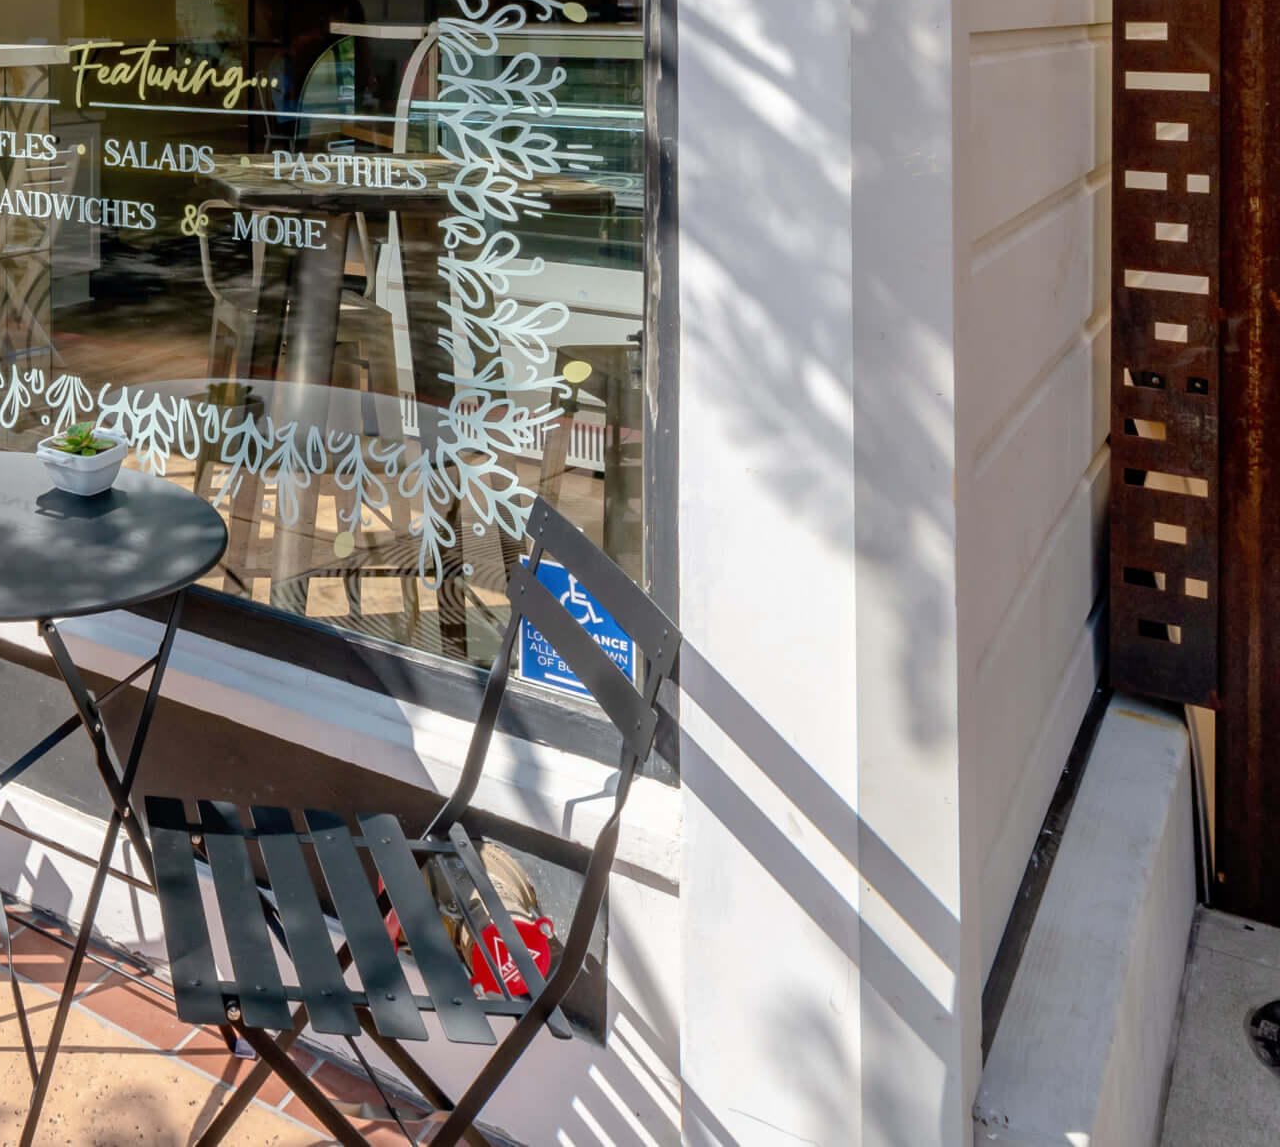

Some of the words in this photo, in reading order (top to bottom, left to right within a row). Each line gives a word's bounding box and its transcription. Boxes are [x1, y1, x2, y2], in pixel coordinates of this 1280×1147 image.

[103, 139, 215, 175] SALADS
[271, 150, 428, 191] PASTRIES
[180, 204, 209, 237] &
[232, 211, 327, 251] MORE
[529, 642, 560, 659] ALLE
[591, 634, 628, 651] ANCE
[537, 655, 555, 667] OF
